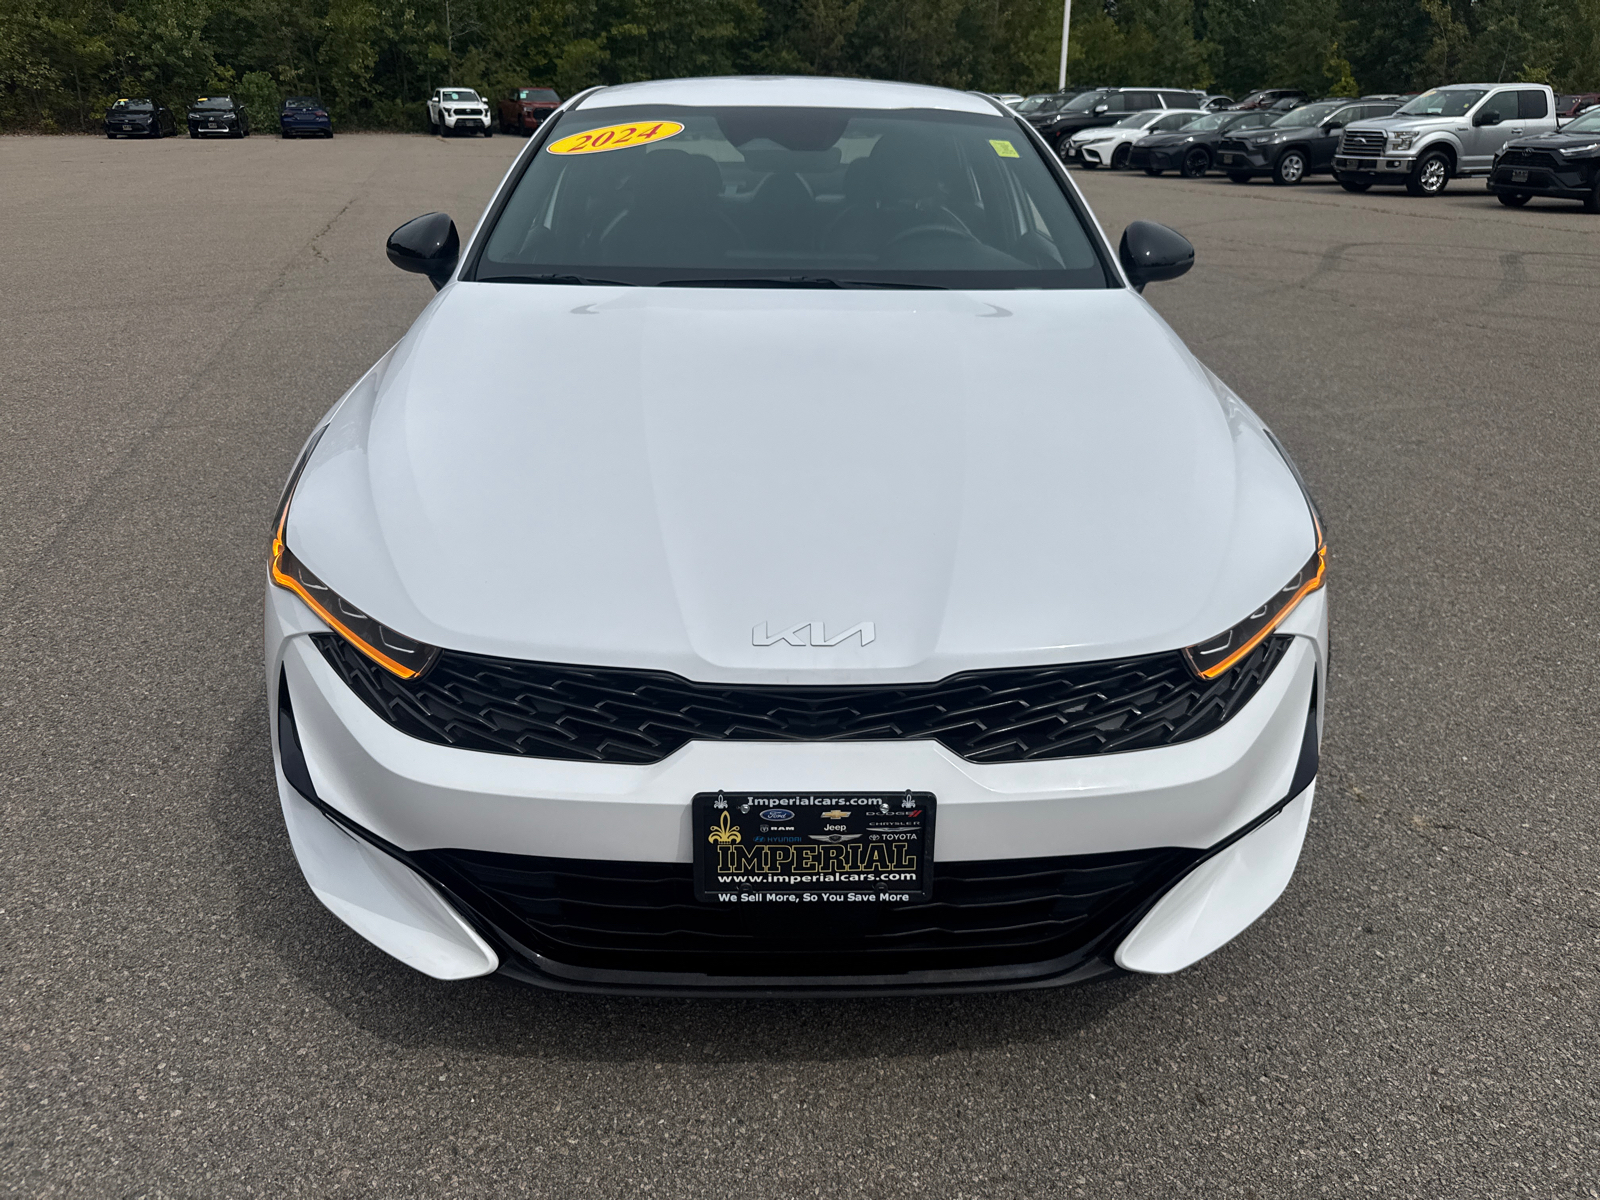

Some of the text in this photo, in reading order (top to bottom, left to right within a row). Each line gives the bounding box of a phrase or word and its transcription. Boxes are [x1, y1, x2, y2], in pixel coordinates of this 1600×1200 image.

[566, 123, 664, 152] 2024
[752, 620, 876, 647] KIA
[747, 796, 883, 807] Imperialcars.com
[767, 811, 787, 819] Ford
[823, 823, 847, 832] Jeep
[717, 843, 917, 873] IMPERIAL
[717, 872, 917, 884] www.imperialcars.com
[718, 893, 910, 903] We Sell More, So You Save More
